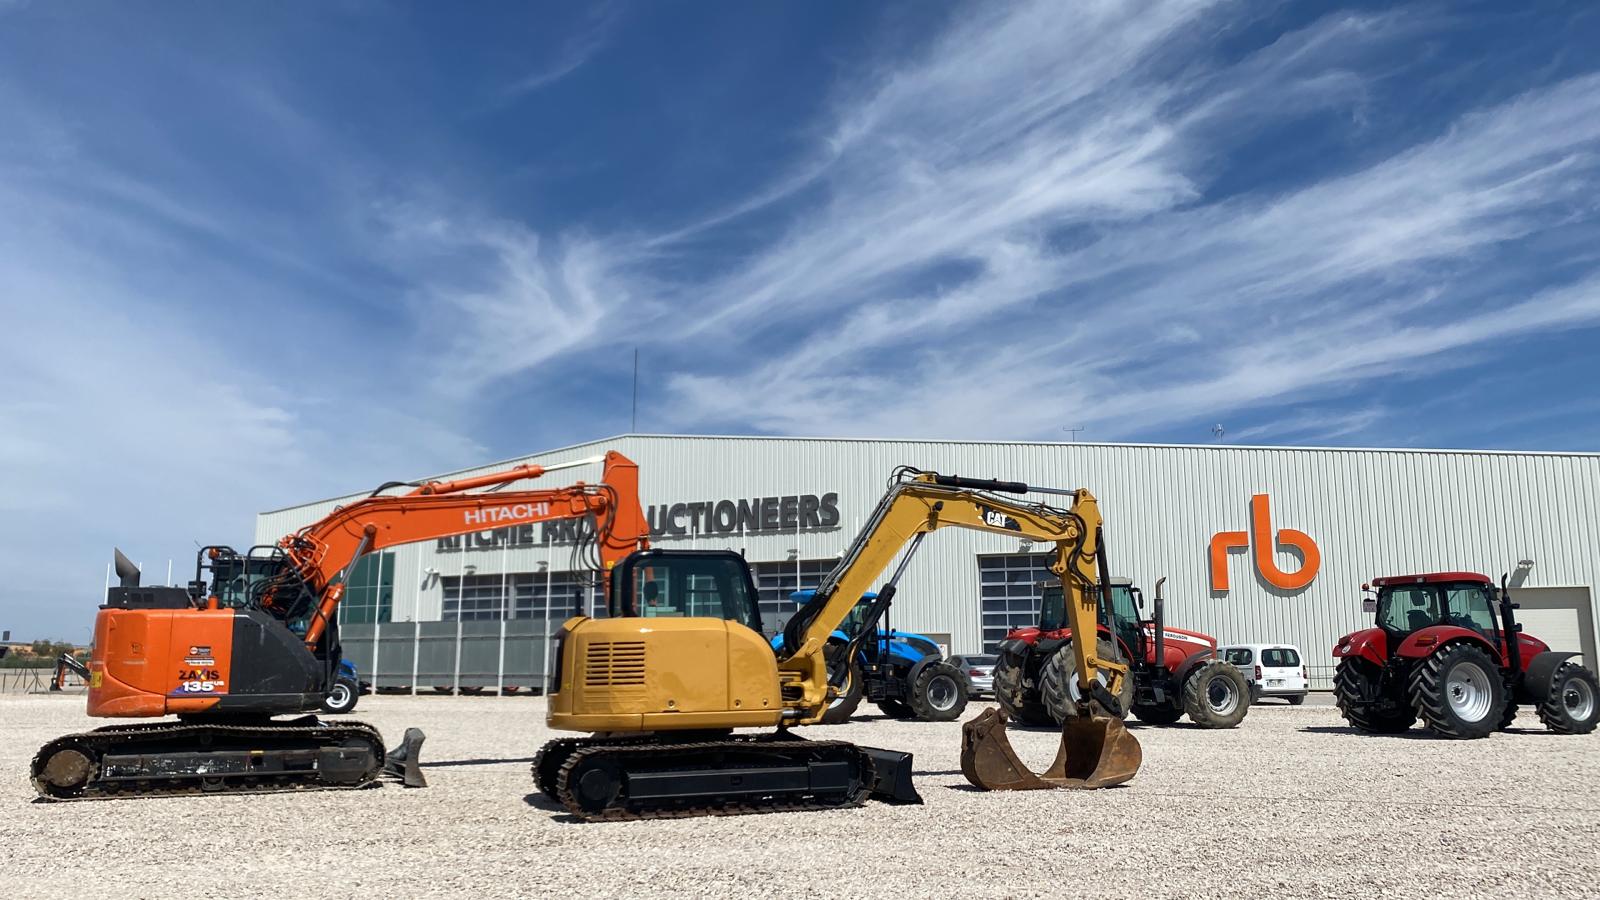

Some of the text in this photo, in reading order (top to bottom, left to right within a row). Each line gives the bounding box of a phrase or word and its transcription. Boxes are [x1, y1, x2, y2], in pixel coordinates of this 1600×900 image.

[464, 503, 550, 525] HITACHI
[647, 491, 840, 536] UCTIONEERS
[986, 511, 1007, 528] CAT
[1210, 493, 1321, 590] rb
[178, 669, 220, 681] ZAXIS
[182, 681, 215, 692] 135
